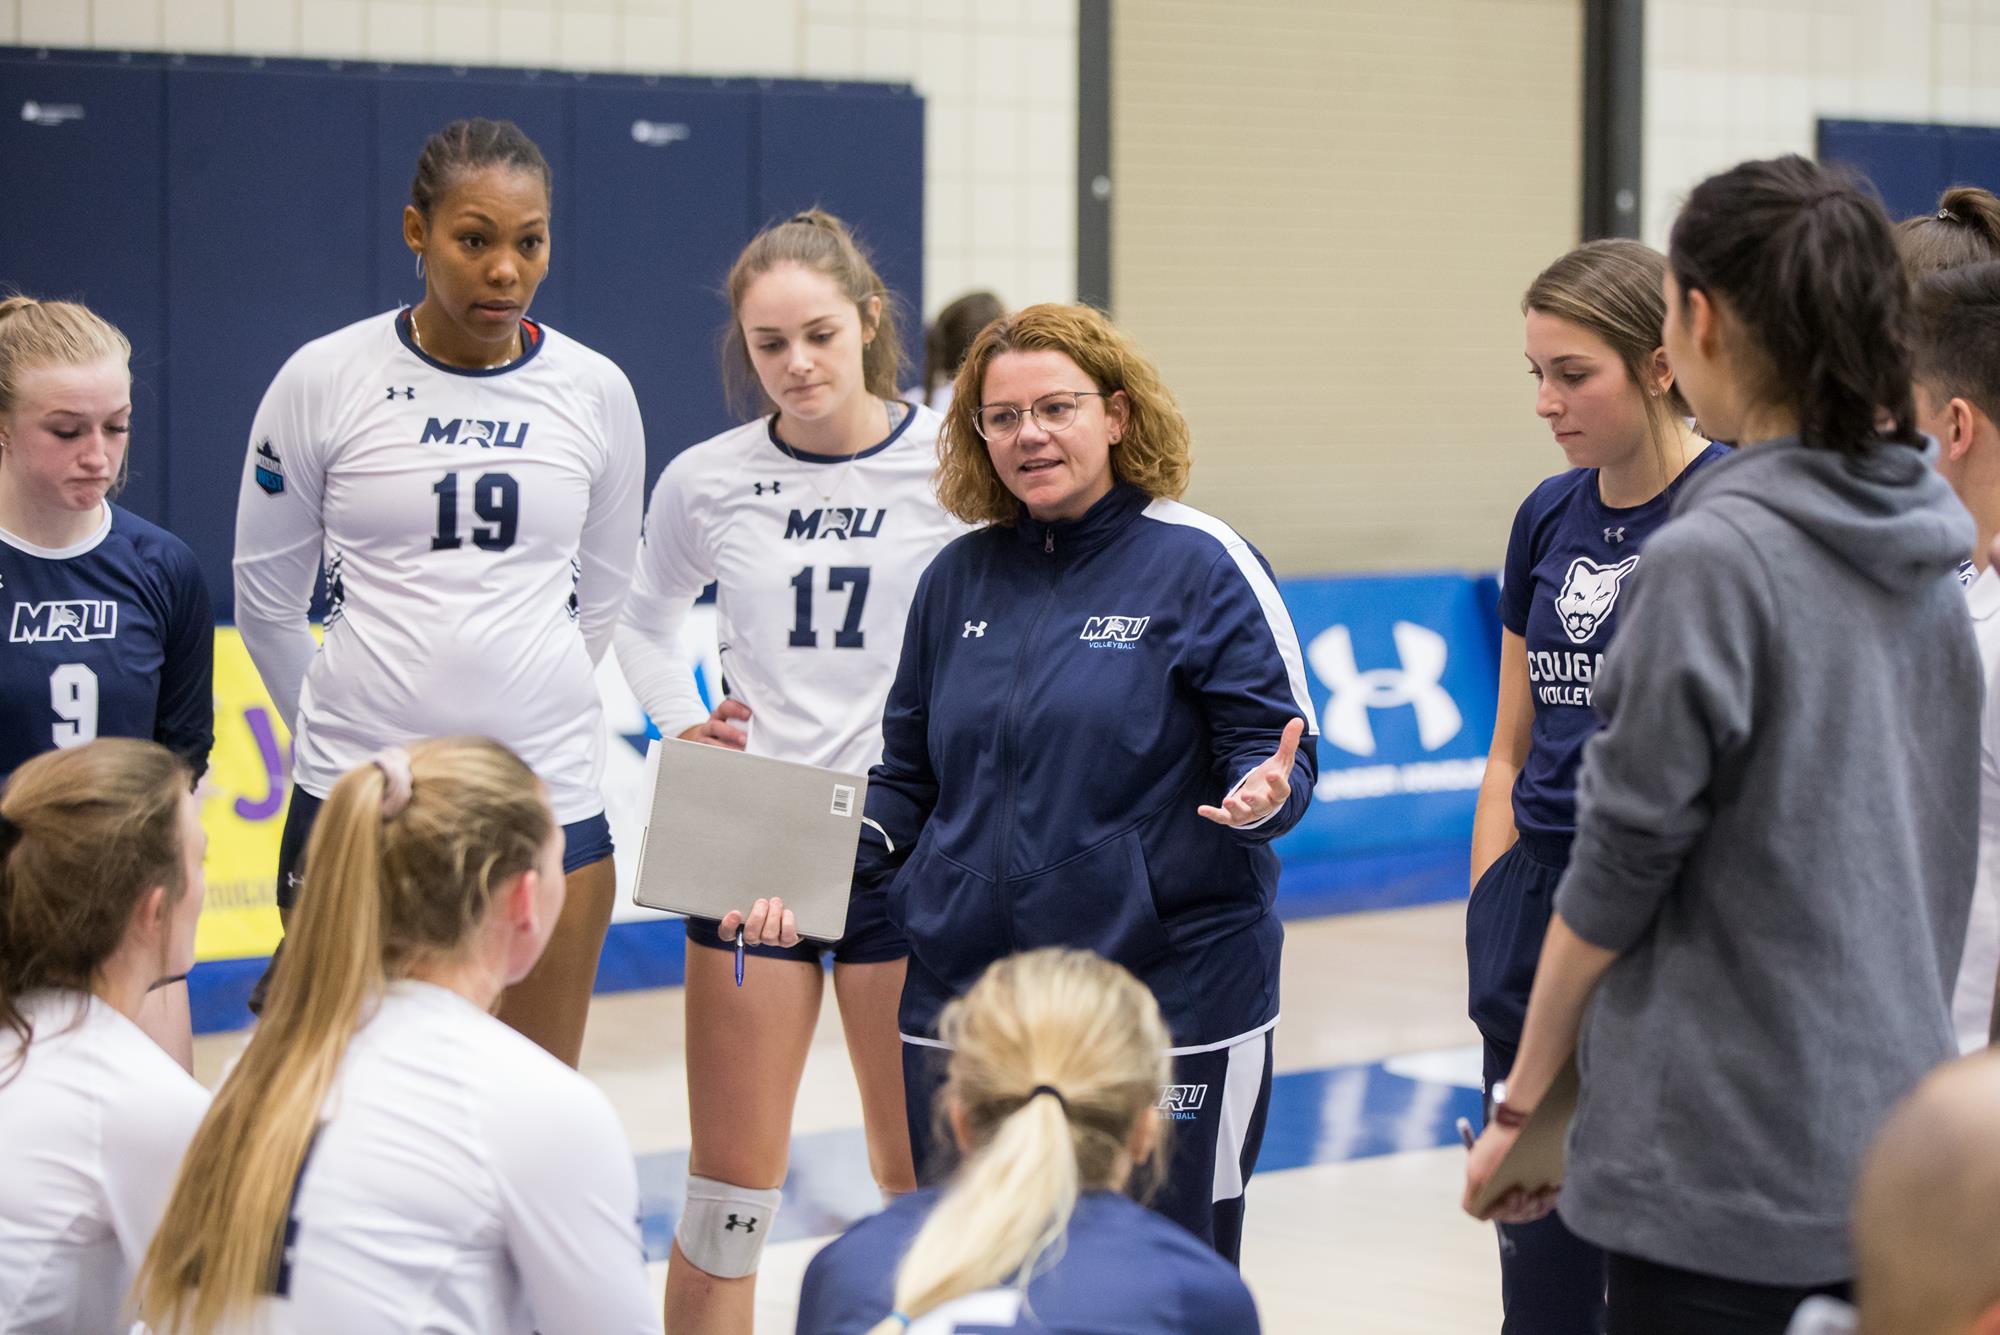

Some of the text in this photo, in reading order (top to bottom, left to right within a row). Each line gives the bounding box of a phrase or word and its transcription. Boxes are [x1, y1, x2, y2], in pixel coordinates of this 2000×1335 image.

[420, 417, 530, 449] MRU
[430, 472, 519, 552] 19
[783, 507, 887, 541] MRU
[9, 600, 118, 644] MRU
[788, 565, 872, 649] 17
[1080, 616, 1151, 642] MRU
[1088, 641, 1137, 650] VOLLEYBALL
[50, 663, 99, 751] 9
[235, 708, 295, 822] J
